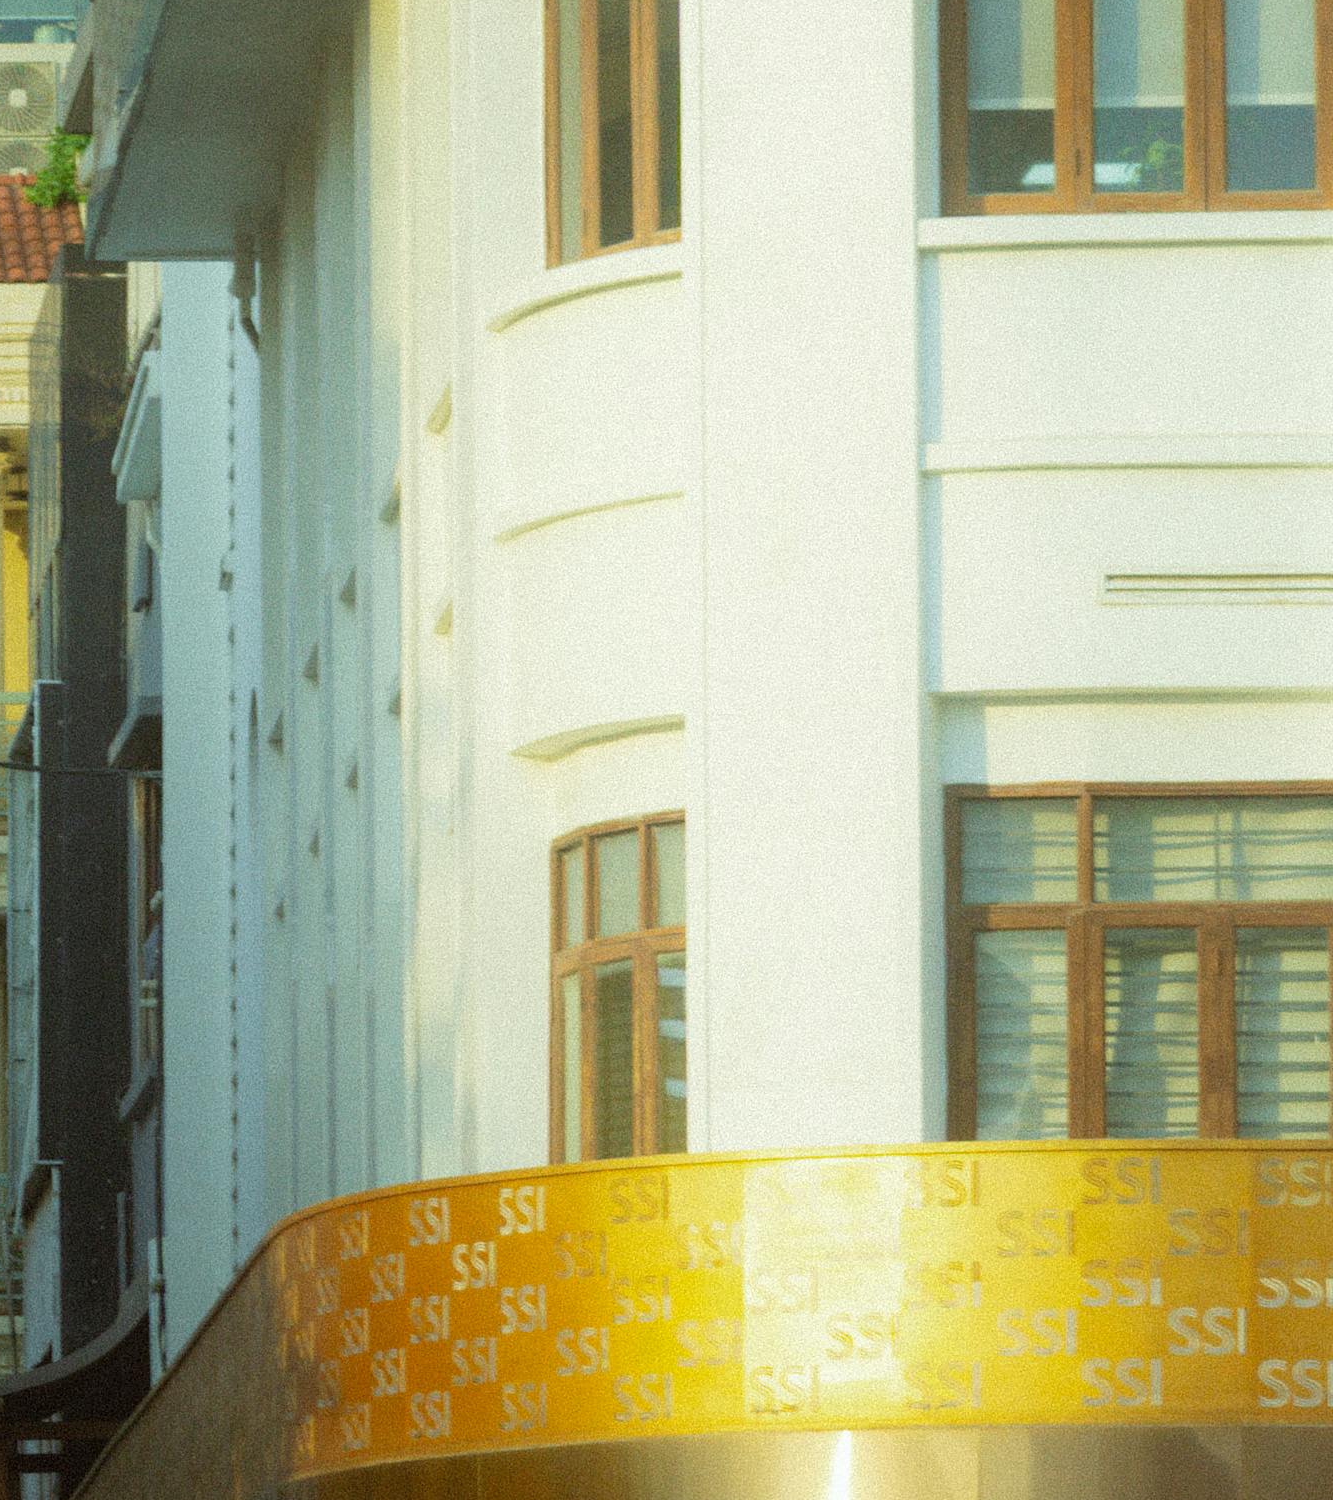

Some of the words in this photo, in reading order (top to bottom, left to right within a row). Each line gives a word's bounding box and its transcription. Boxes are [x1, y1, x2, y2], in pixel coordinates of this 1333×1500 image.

[611, 1176, 669, 1225] SSI
[1083, 1157, 1161, 1205] SSI
[409, 1197, 450, 1247] SSI
[499, 1186, 545, 1236] SSI
[996, 1209, 1075, 1258] SSI
[1168, 1207, 1248, 1257] SSI
[452, 1241, 496, 1291] SSI
[1083, 1258, 1162, 1307] SSI
[501, 1285, 546, 1335] SSI
[613, 1276, 671, 1325] SSI
[557, 1327, 610, 1376] SSI
[997, 1307, 1077, 1357] SSI
[1168, 1306, 1247, 1357] SSI
[501, 1382, 547, 1431] SSI
[613, 1373, 673, 1422] SSI
[750, 1365, 820, 1414] SSI
[1083, 1358, 1162, 1407] SSI
